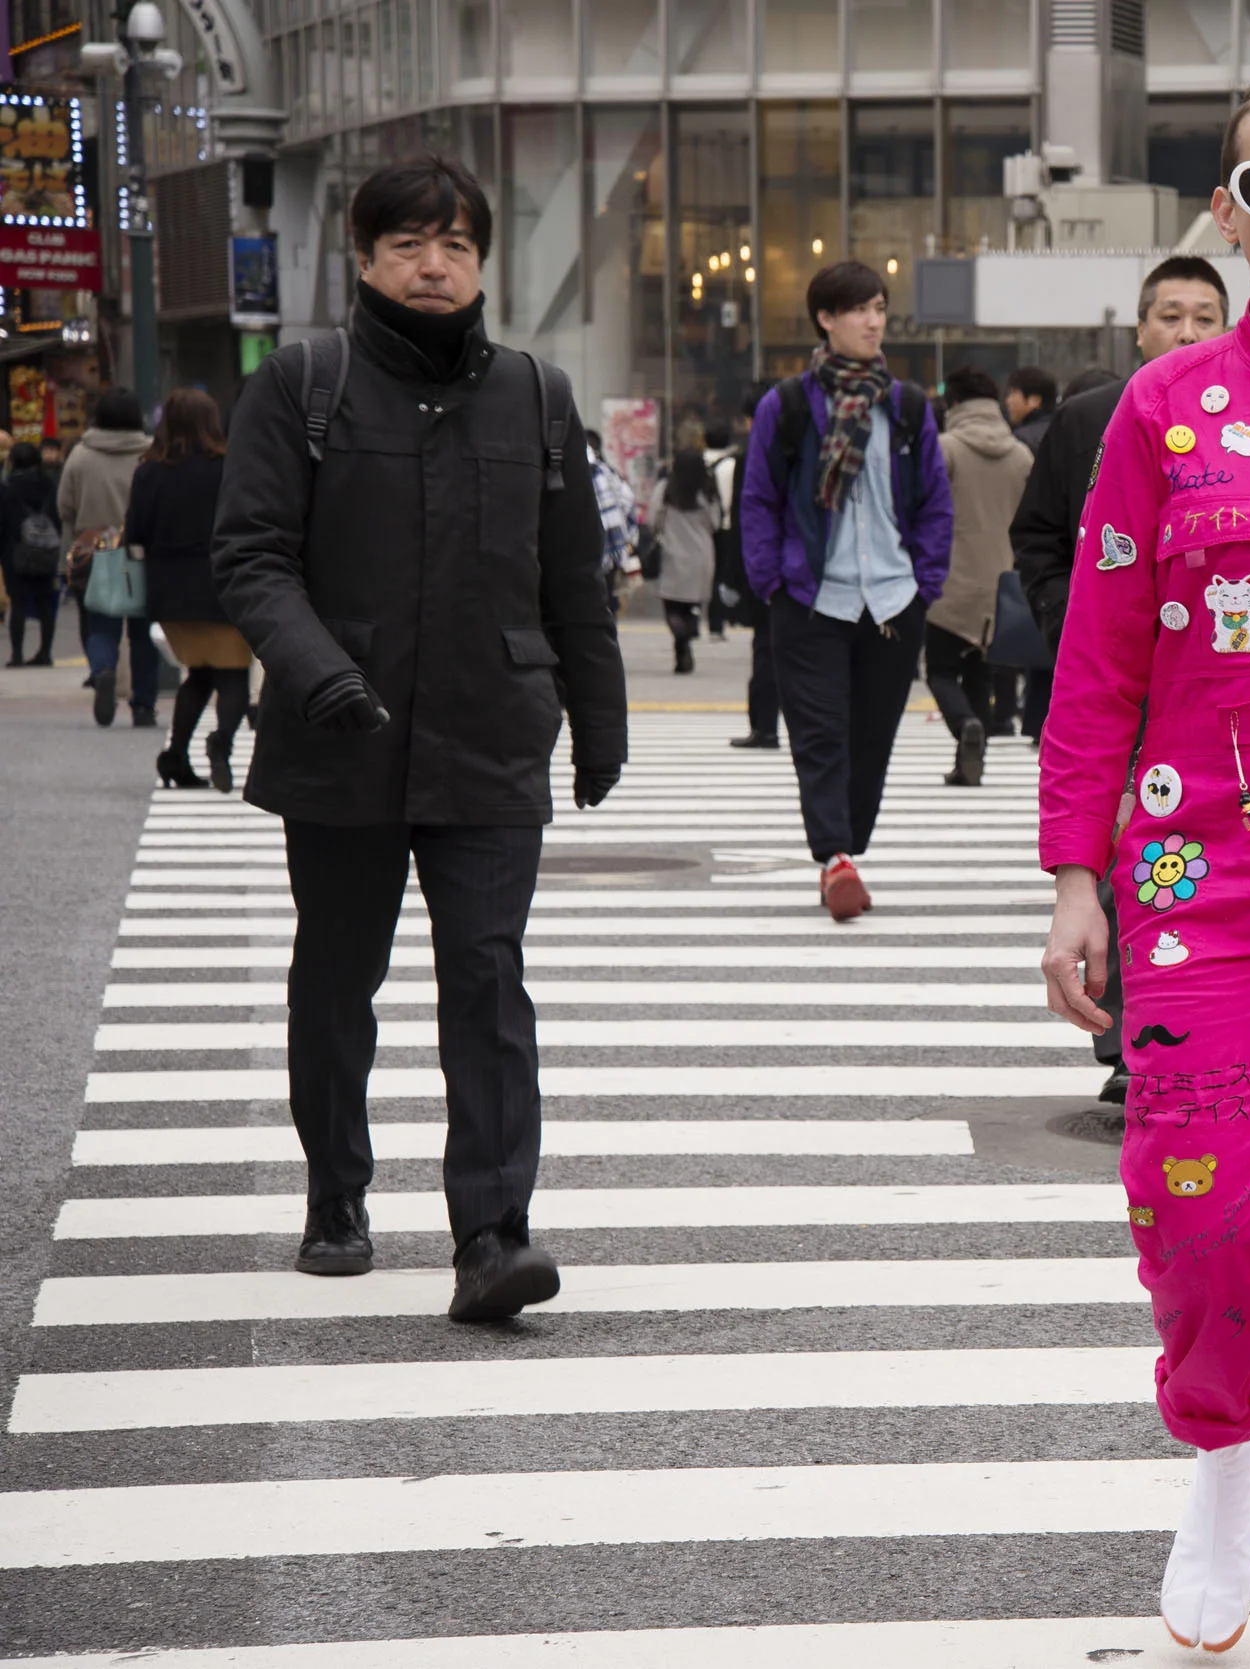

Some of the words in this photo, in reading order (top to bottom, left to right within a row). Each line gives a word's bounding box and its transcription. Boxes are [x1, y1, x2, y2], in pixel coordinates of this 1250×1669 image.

[1166, 462, 1234, 494] Kate
[1184, 507, 1249, 536] ケイト
